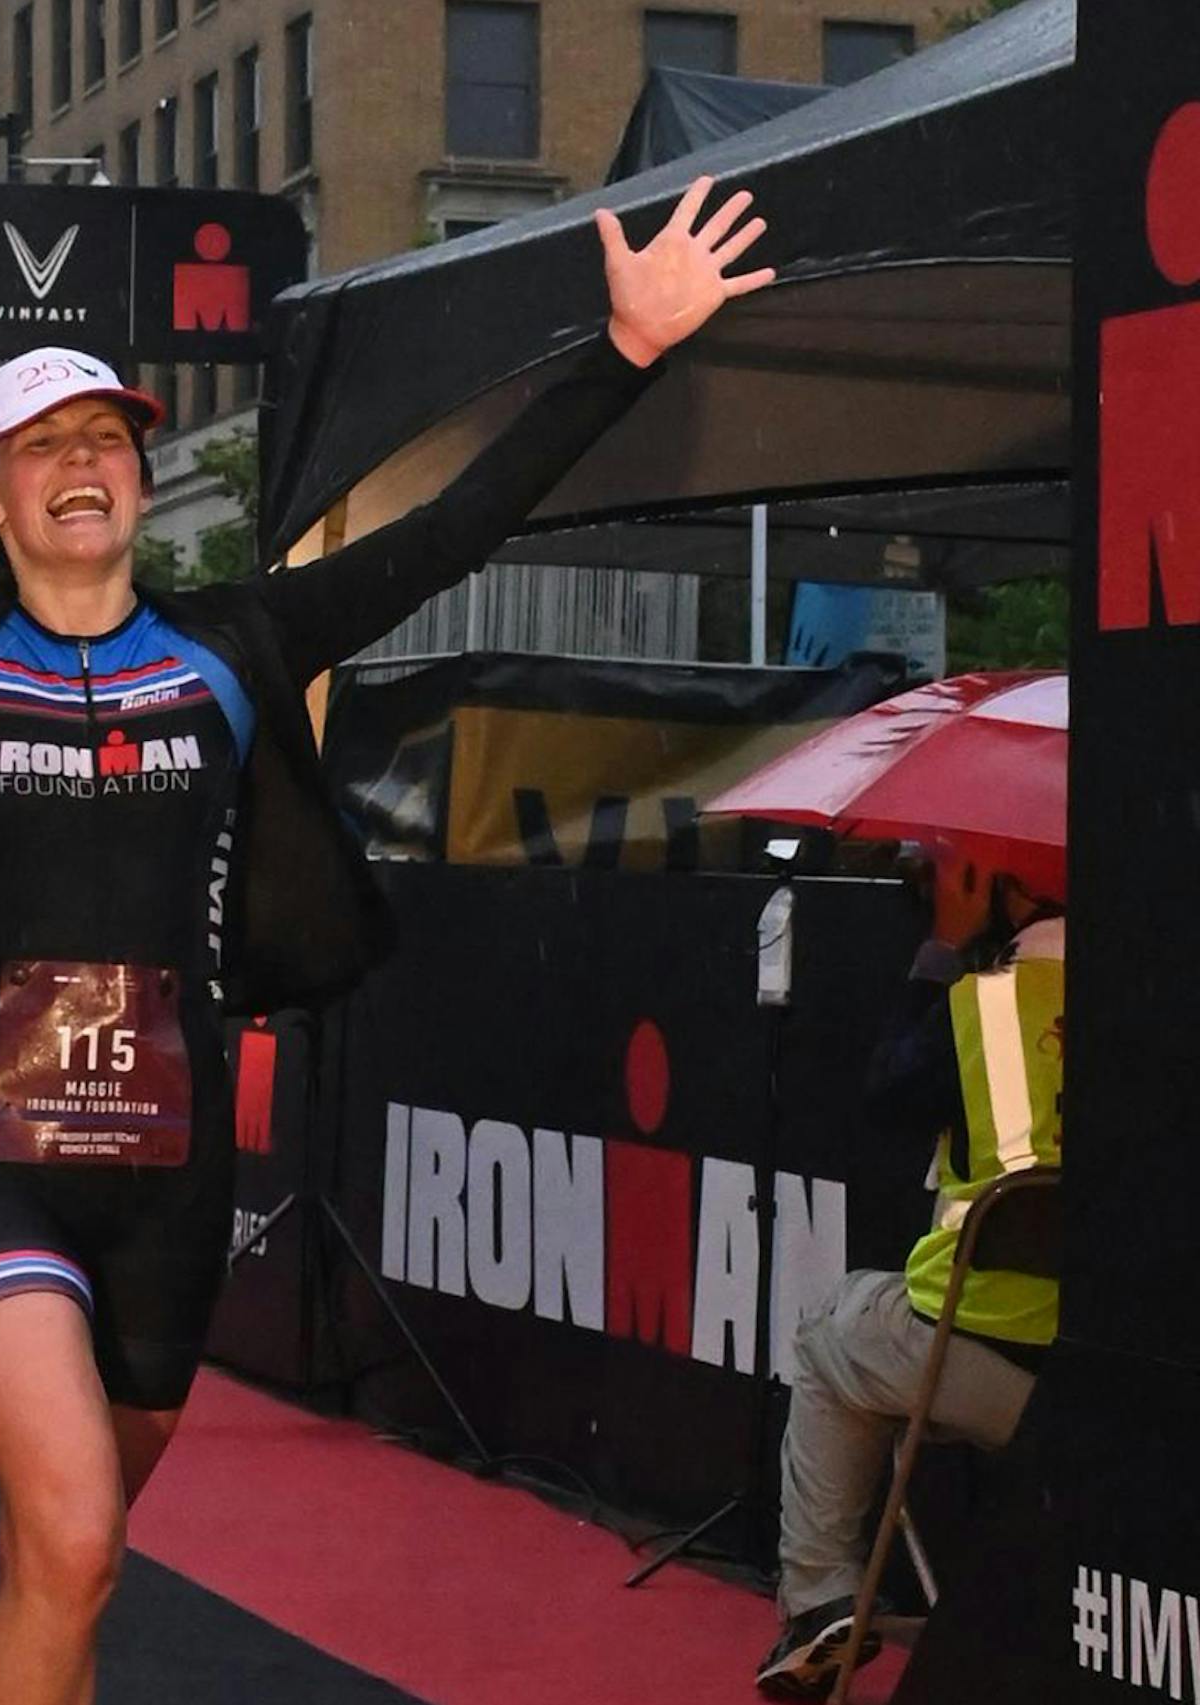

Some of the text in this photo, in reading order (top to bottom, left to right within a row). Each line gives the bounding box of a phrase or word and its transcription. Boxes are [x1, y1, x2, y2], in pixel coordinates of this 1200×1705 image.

[0, 771, 190, 799] FOUNDATION
[56, 1026, 135, 1072] 115
[26, 1098, 159, 1115] IRONMAN FOUNDATION
[65, 1081, 123, 1097] MAGGIE
[381, 1100, 847, 1386] IRONMAN
[1072, 1564, 1200, 1705] #IM
